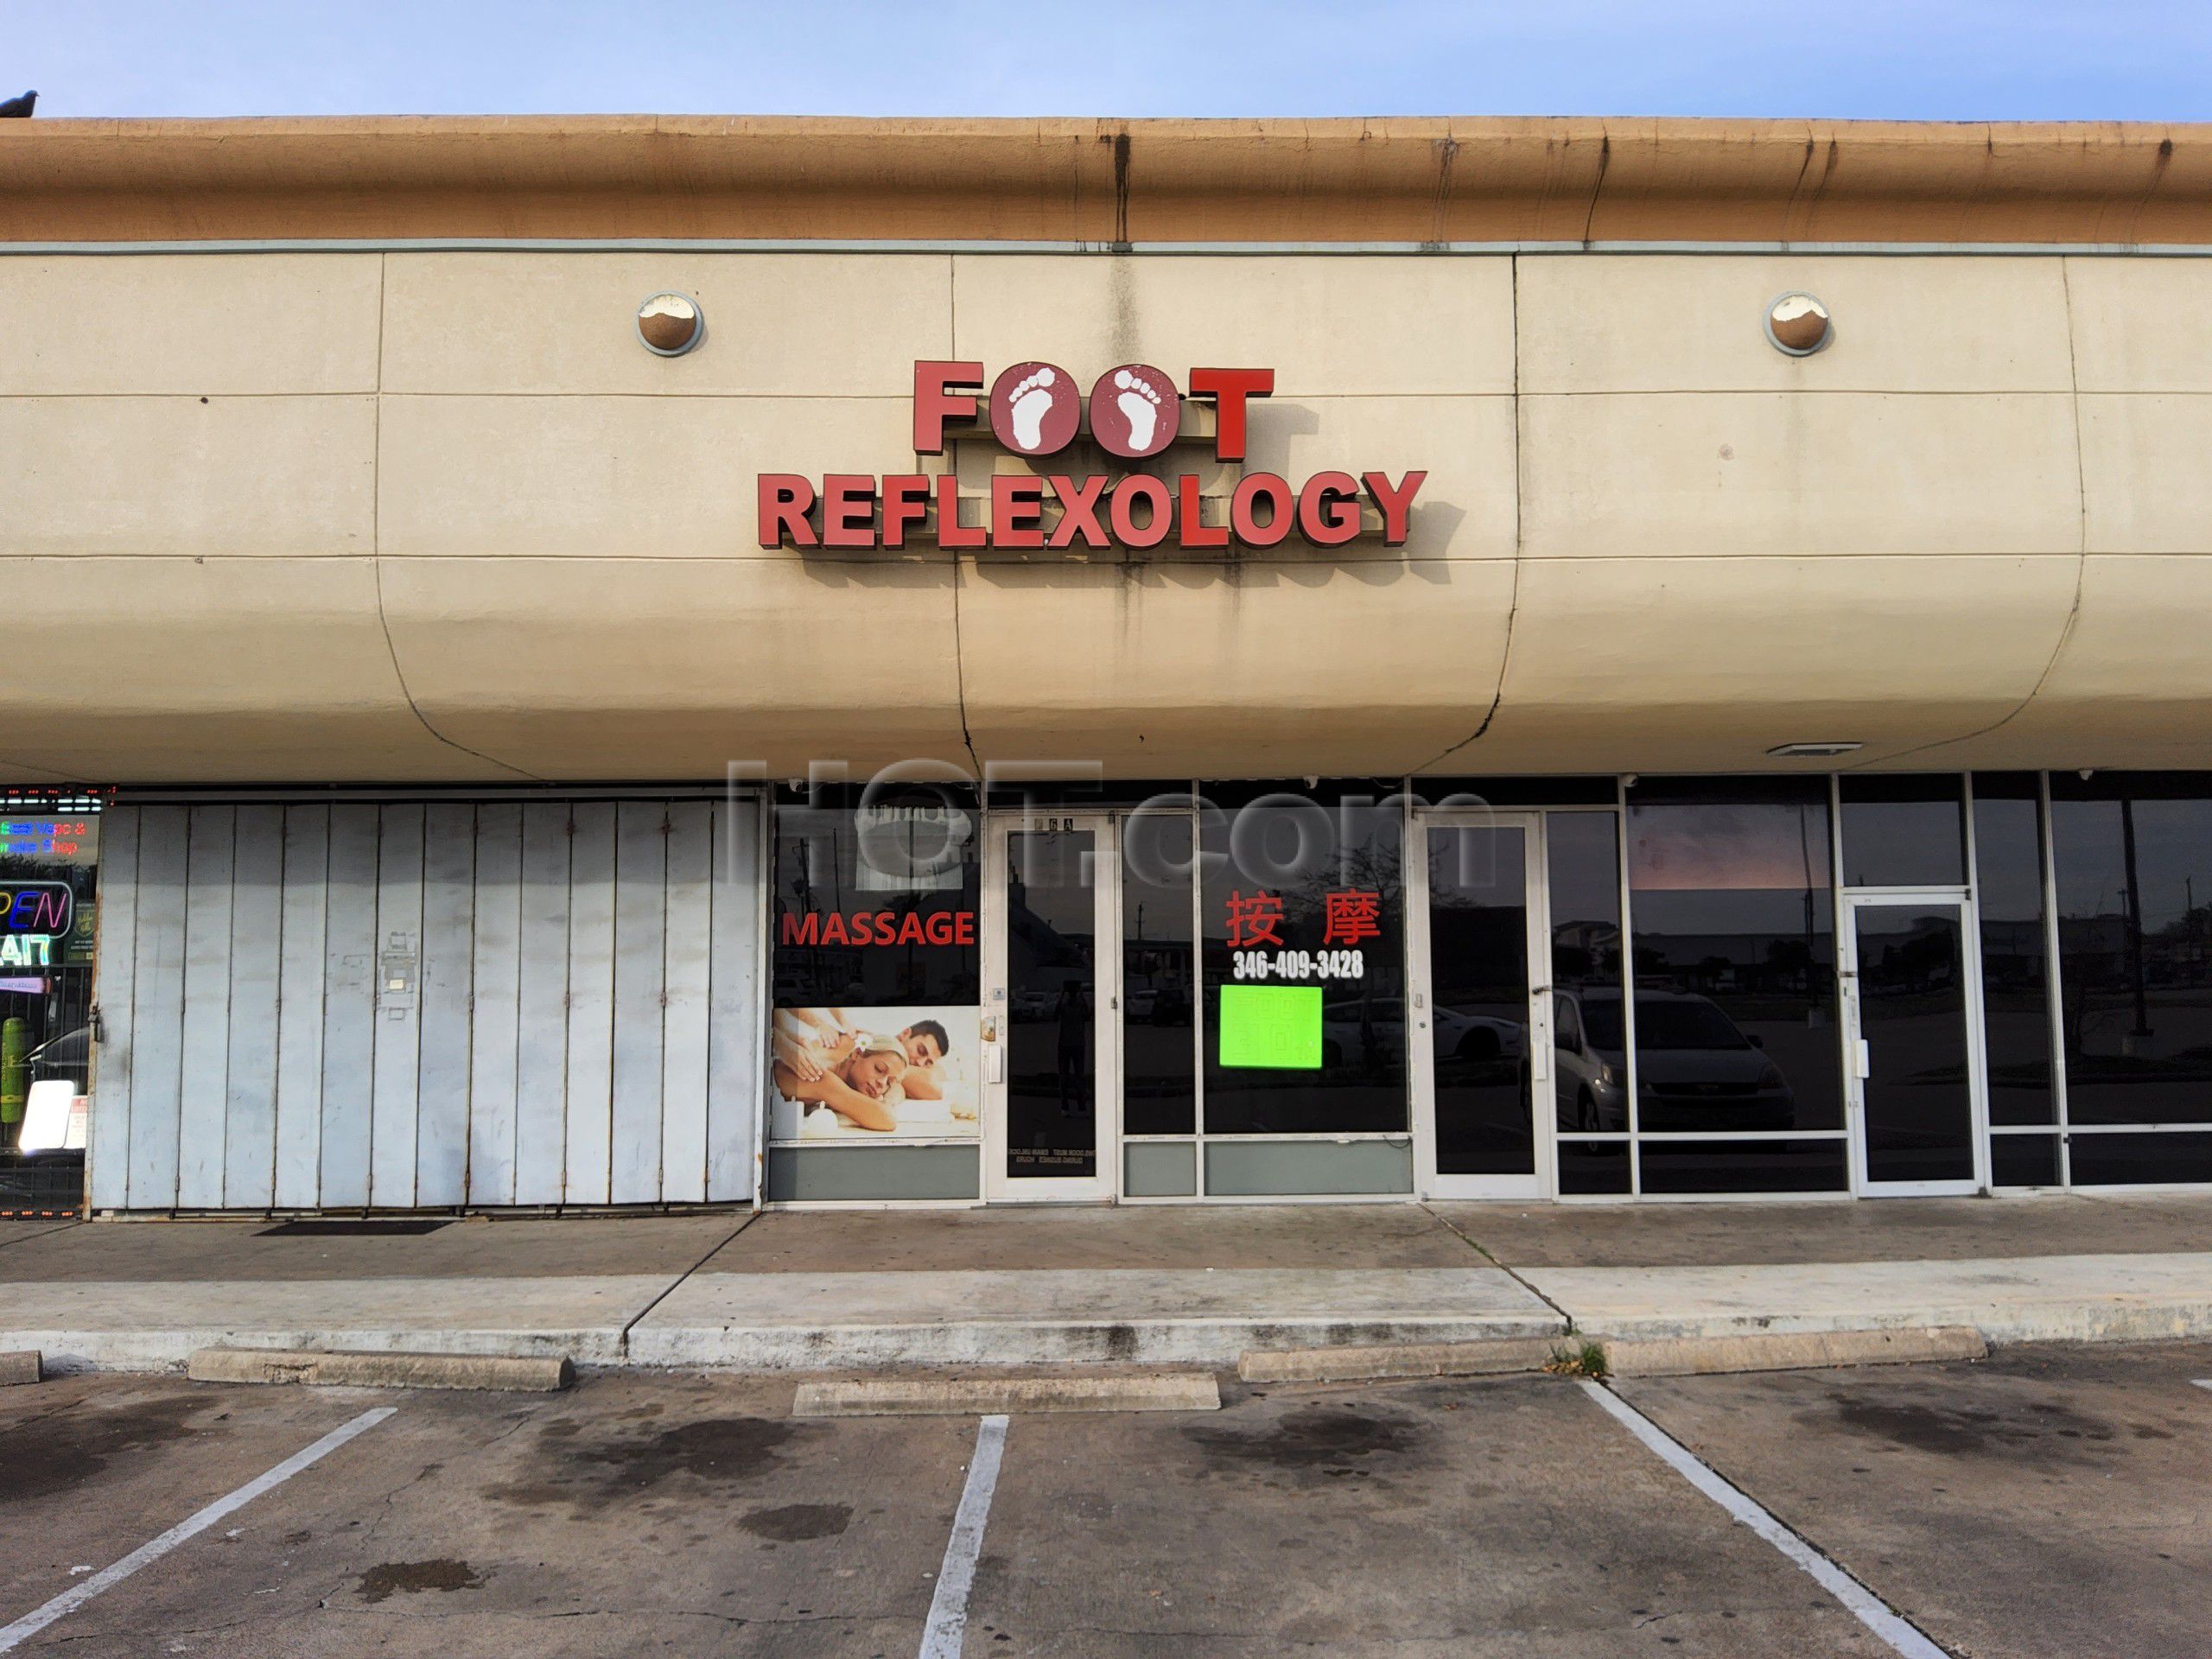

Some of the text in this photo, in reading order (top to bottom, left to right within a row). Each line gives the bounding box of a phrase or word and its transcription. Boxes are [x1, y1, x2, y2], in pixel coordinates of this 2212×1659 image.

[913, 360, 1275, 463] FOOT
[757, 471, 1429, 550] REFLEXOLOGY
[782, 912, 975, 946] MASSAGE
[1225, 888, 1381, 948] 按摩
[1233, 950, 1364, 980] 346-409-3428
